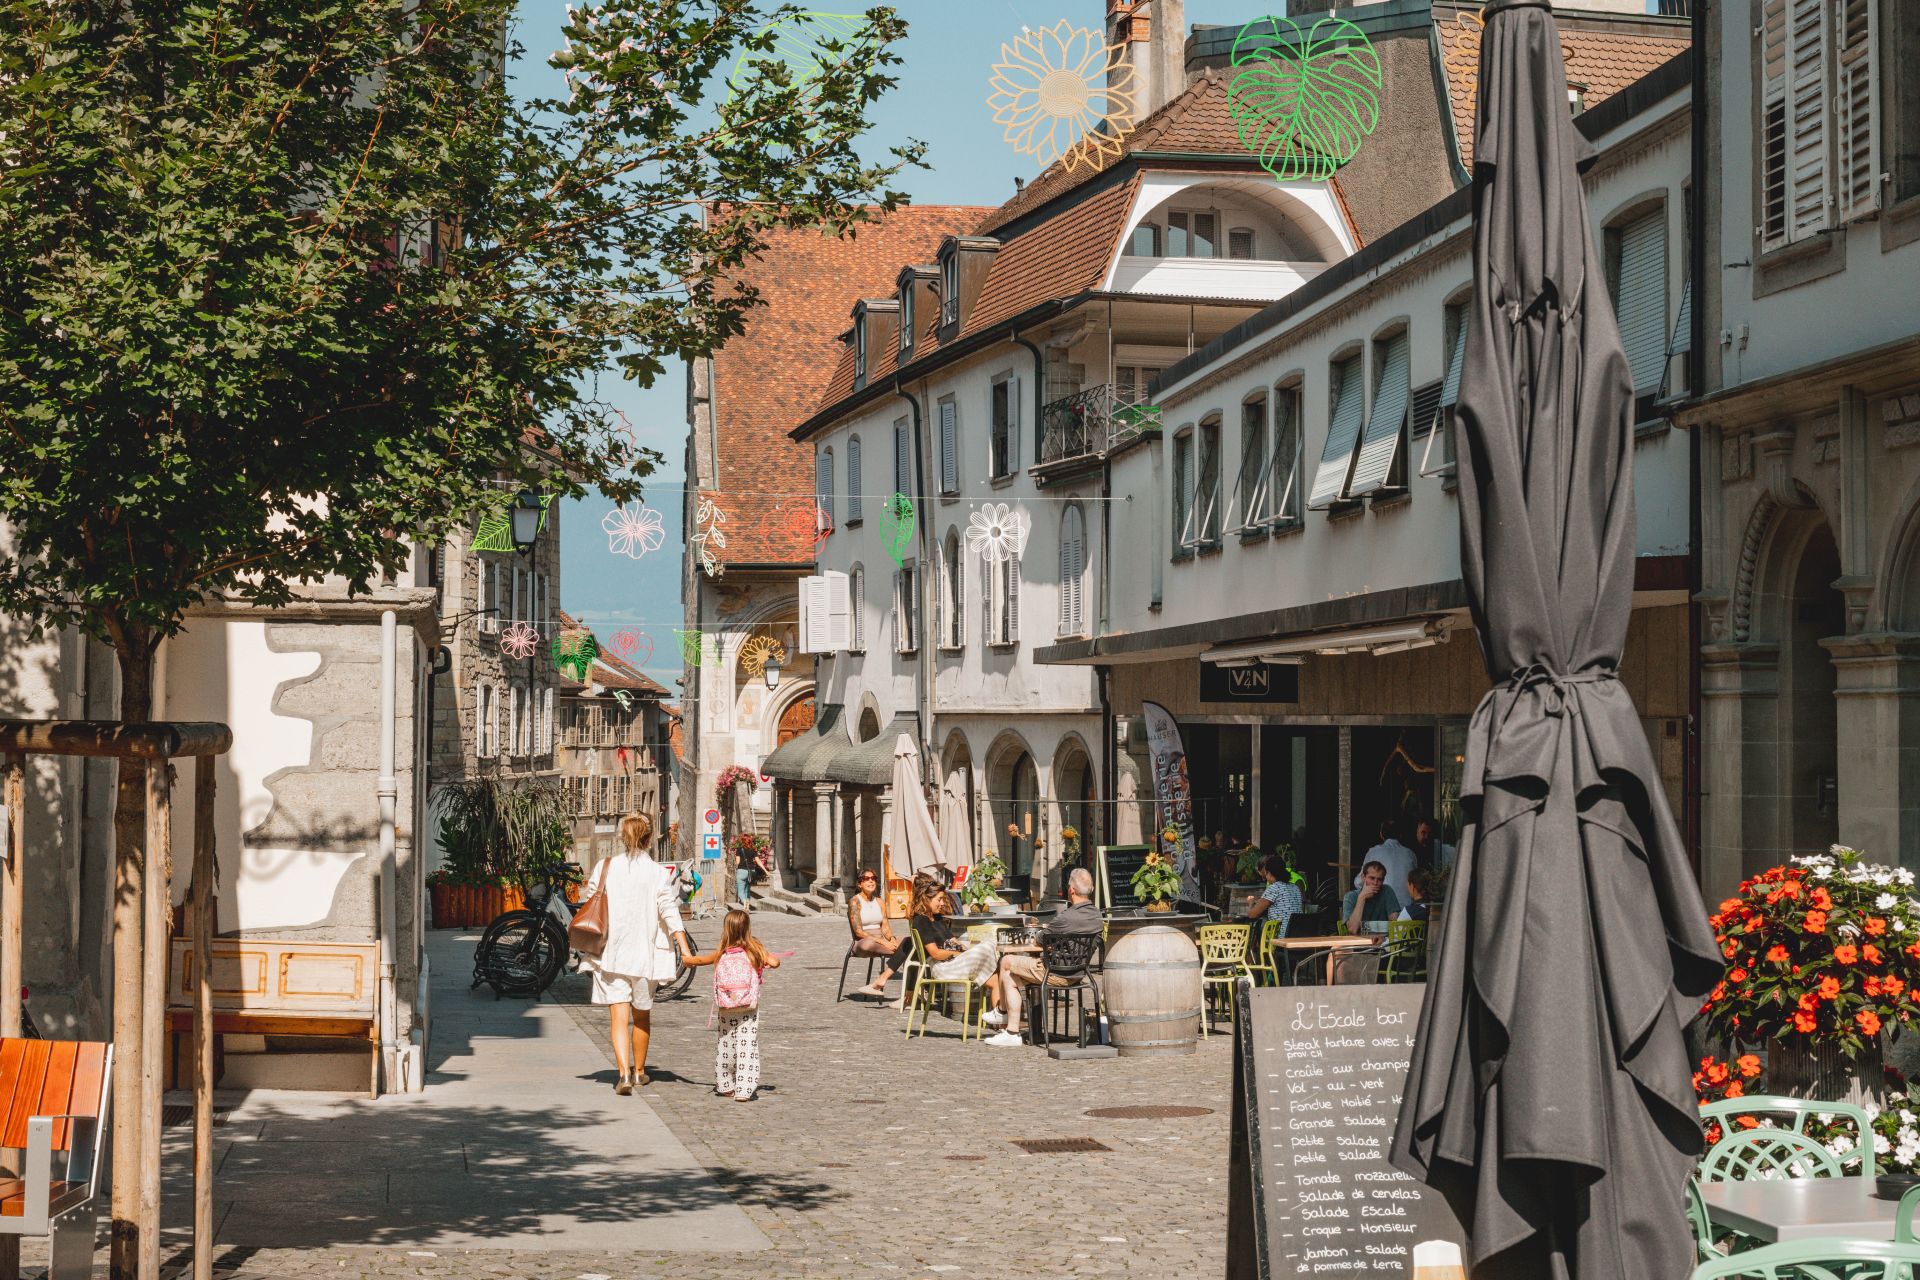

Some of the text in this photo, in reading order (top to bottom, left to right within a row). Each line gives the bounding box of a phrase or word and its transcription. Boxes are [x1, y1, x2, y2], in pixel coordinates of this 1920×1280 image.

[1291, 1002, 1408, 1031] L'Escale bar
[1283, 1037, 1323, 1051] Steak
[1325, 1035, 1365, 1049] tartare
[1371, 1038, 1400, 1048] avec
[1332, 1064, 1354, 1074] aux
[1290, 1100, 1333, 1113] Fondue
[1289, 1116, 1335, 1130] Grande
[1294, 1170, 1341, 1186] Tomate
[1298, 1187, 1421, 1203] Salade de cervelas
[1301, 1204, 1350, 1221] Salade
[1360, 1223, 1418, 1234] Monsieur
[1303, 1245, 1349, 1261] Jambon
[1296, 1262, 1310, 1273] de
[1372, 1258, 1404, 1270] terre
